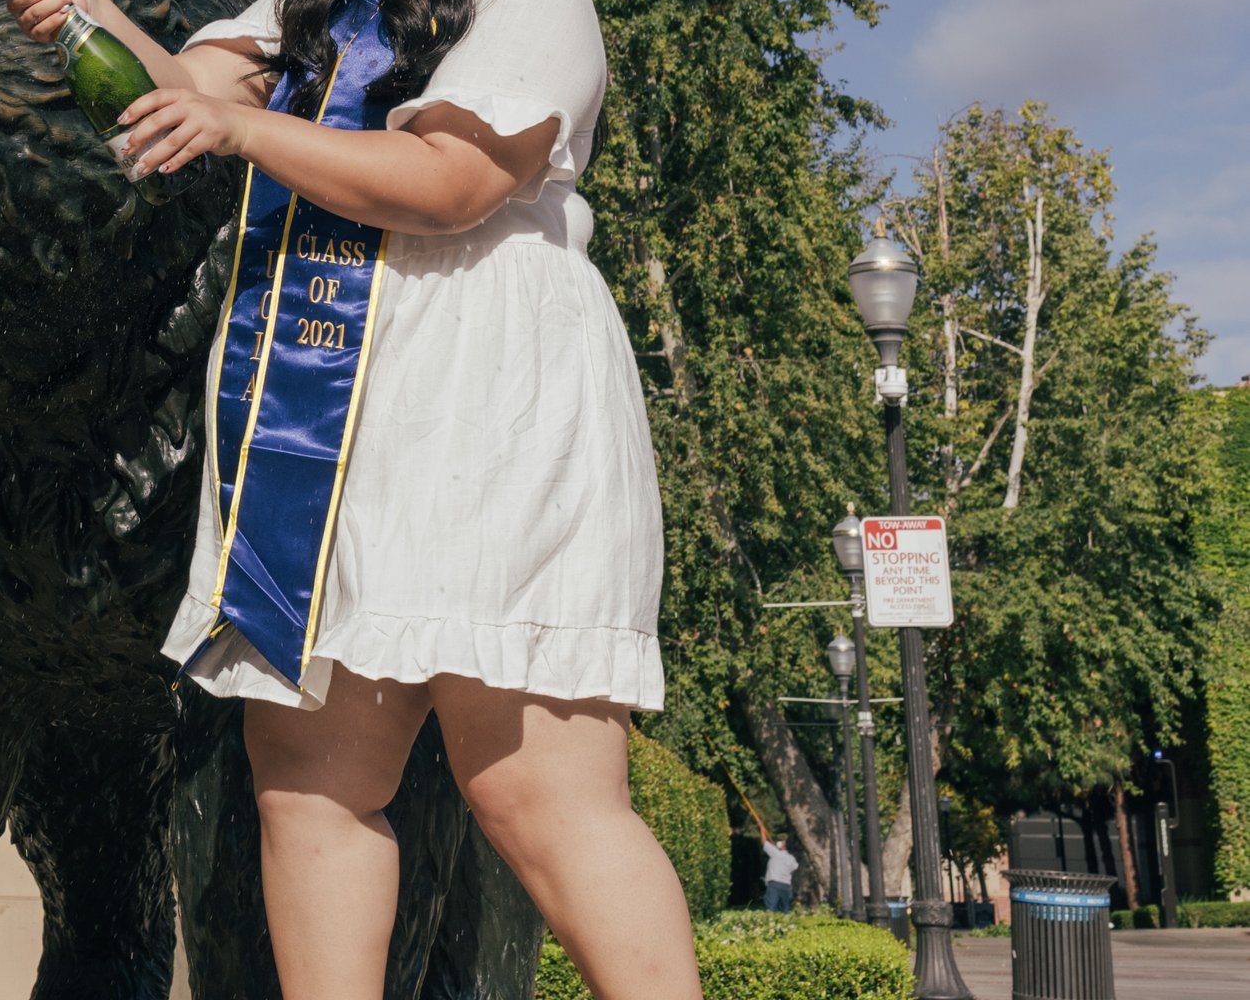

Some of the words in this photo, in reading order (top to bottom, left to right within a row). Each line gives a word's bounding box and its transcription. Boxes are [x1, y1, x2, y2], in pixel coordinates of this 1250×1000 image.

[296, 233, 366, 267] CLASS
[308, 276, 340, 305] OF
[296, 317, 346, 350] 2021
[878, 520, 928, 530] TOW-AWAY
[867, 532, 895, 549] NO
[872, 552, 941, 565] STOPPING
[883, 566, 904, 575] ANY
[907, 566, 930, 575] TIME
[875, 576, 916, 586] BEYOND
[920, 576, 941, 585] THIS
[893, 586, 923, 595] POINT
